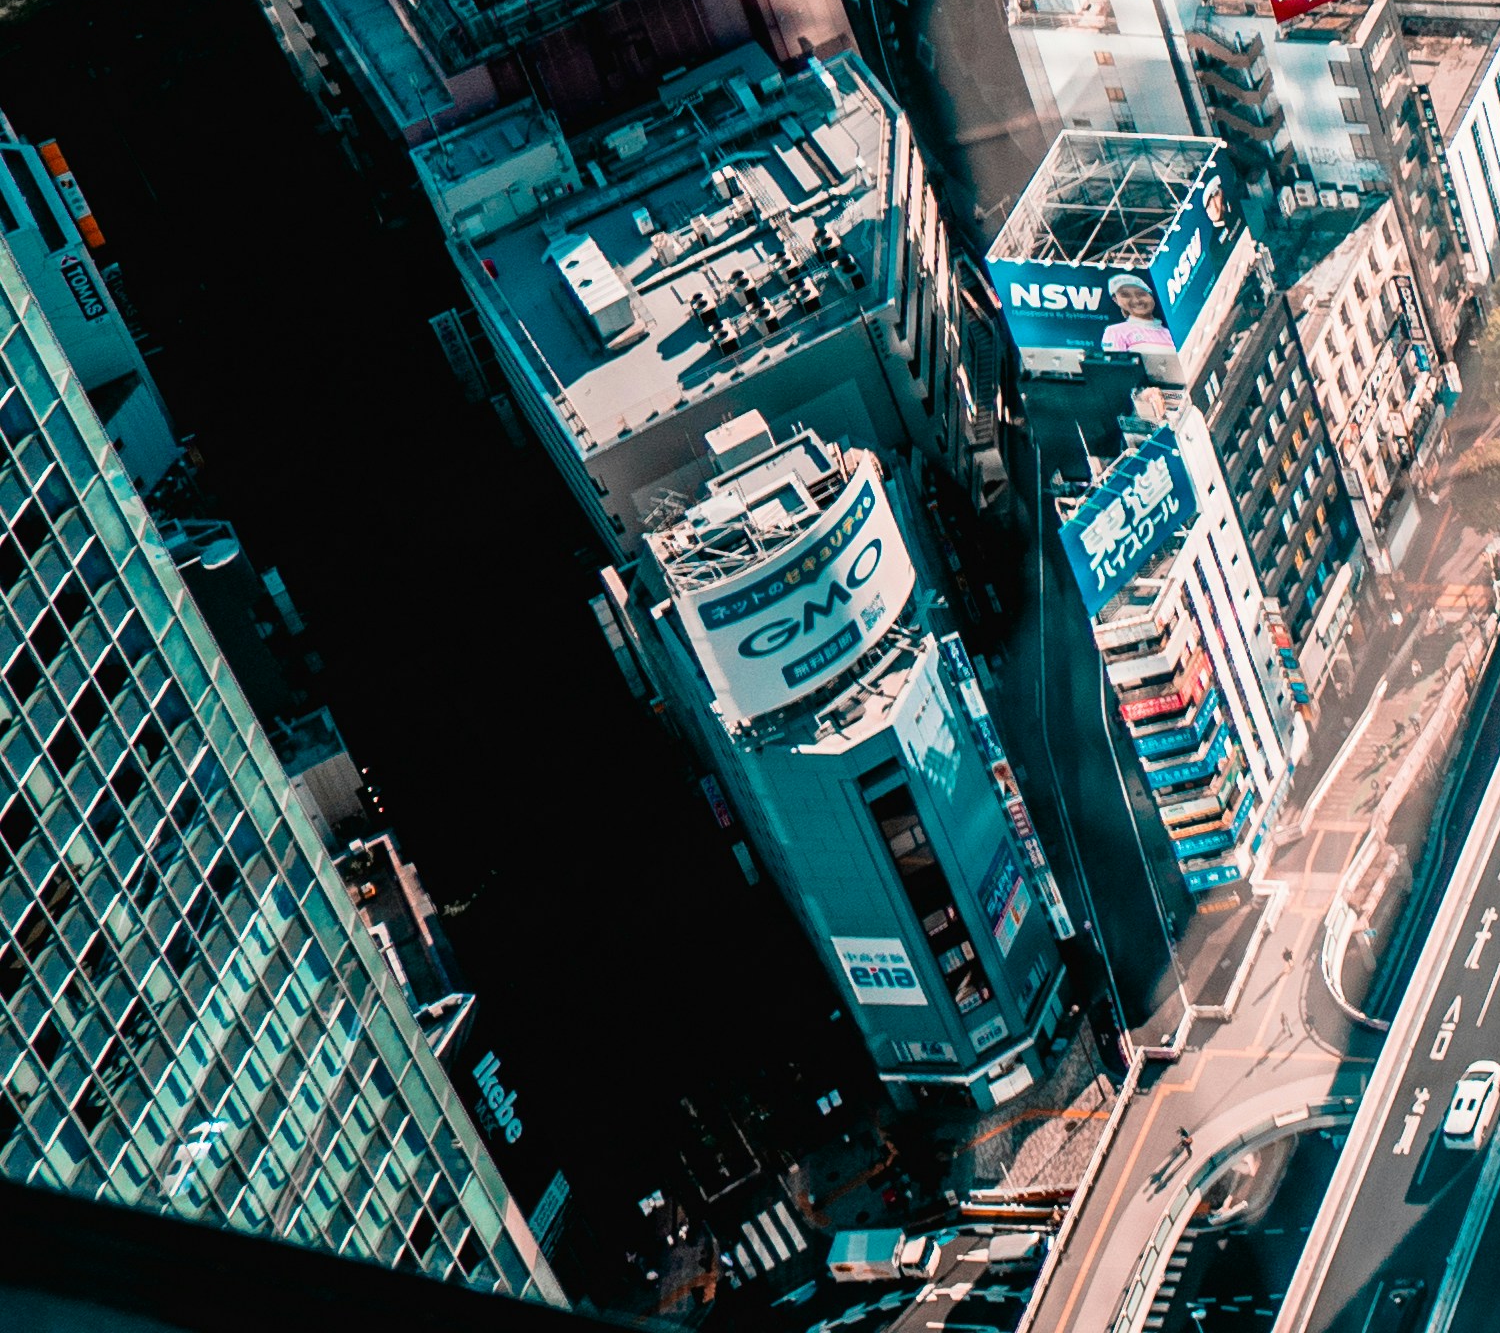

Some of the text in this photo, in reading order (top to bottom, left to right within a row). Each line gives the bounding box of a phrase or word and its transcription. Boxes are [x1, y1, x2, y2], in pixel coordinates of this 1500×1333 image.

[68, 265, 102, 316] TOMAS
[1010, 282, 1102, 311] NSW
[1167, 227, 1201, 305] NSW
[1080, 454, 1173, 570] 東進
[1097, 495, 1180, 592] ハイスクール
[738, 538, 883, 659] GMO
[849, 965, 915, 988] ena
[472, 1051, 522, 1144] Ikebe
